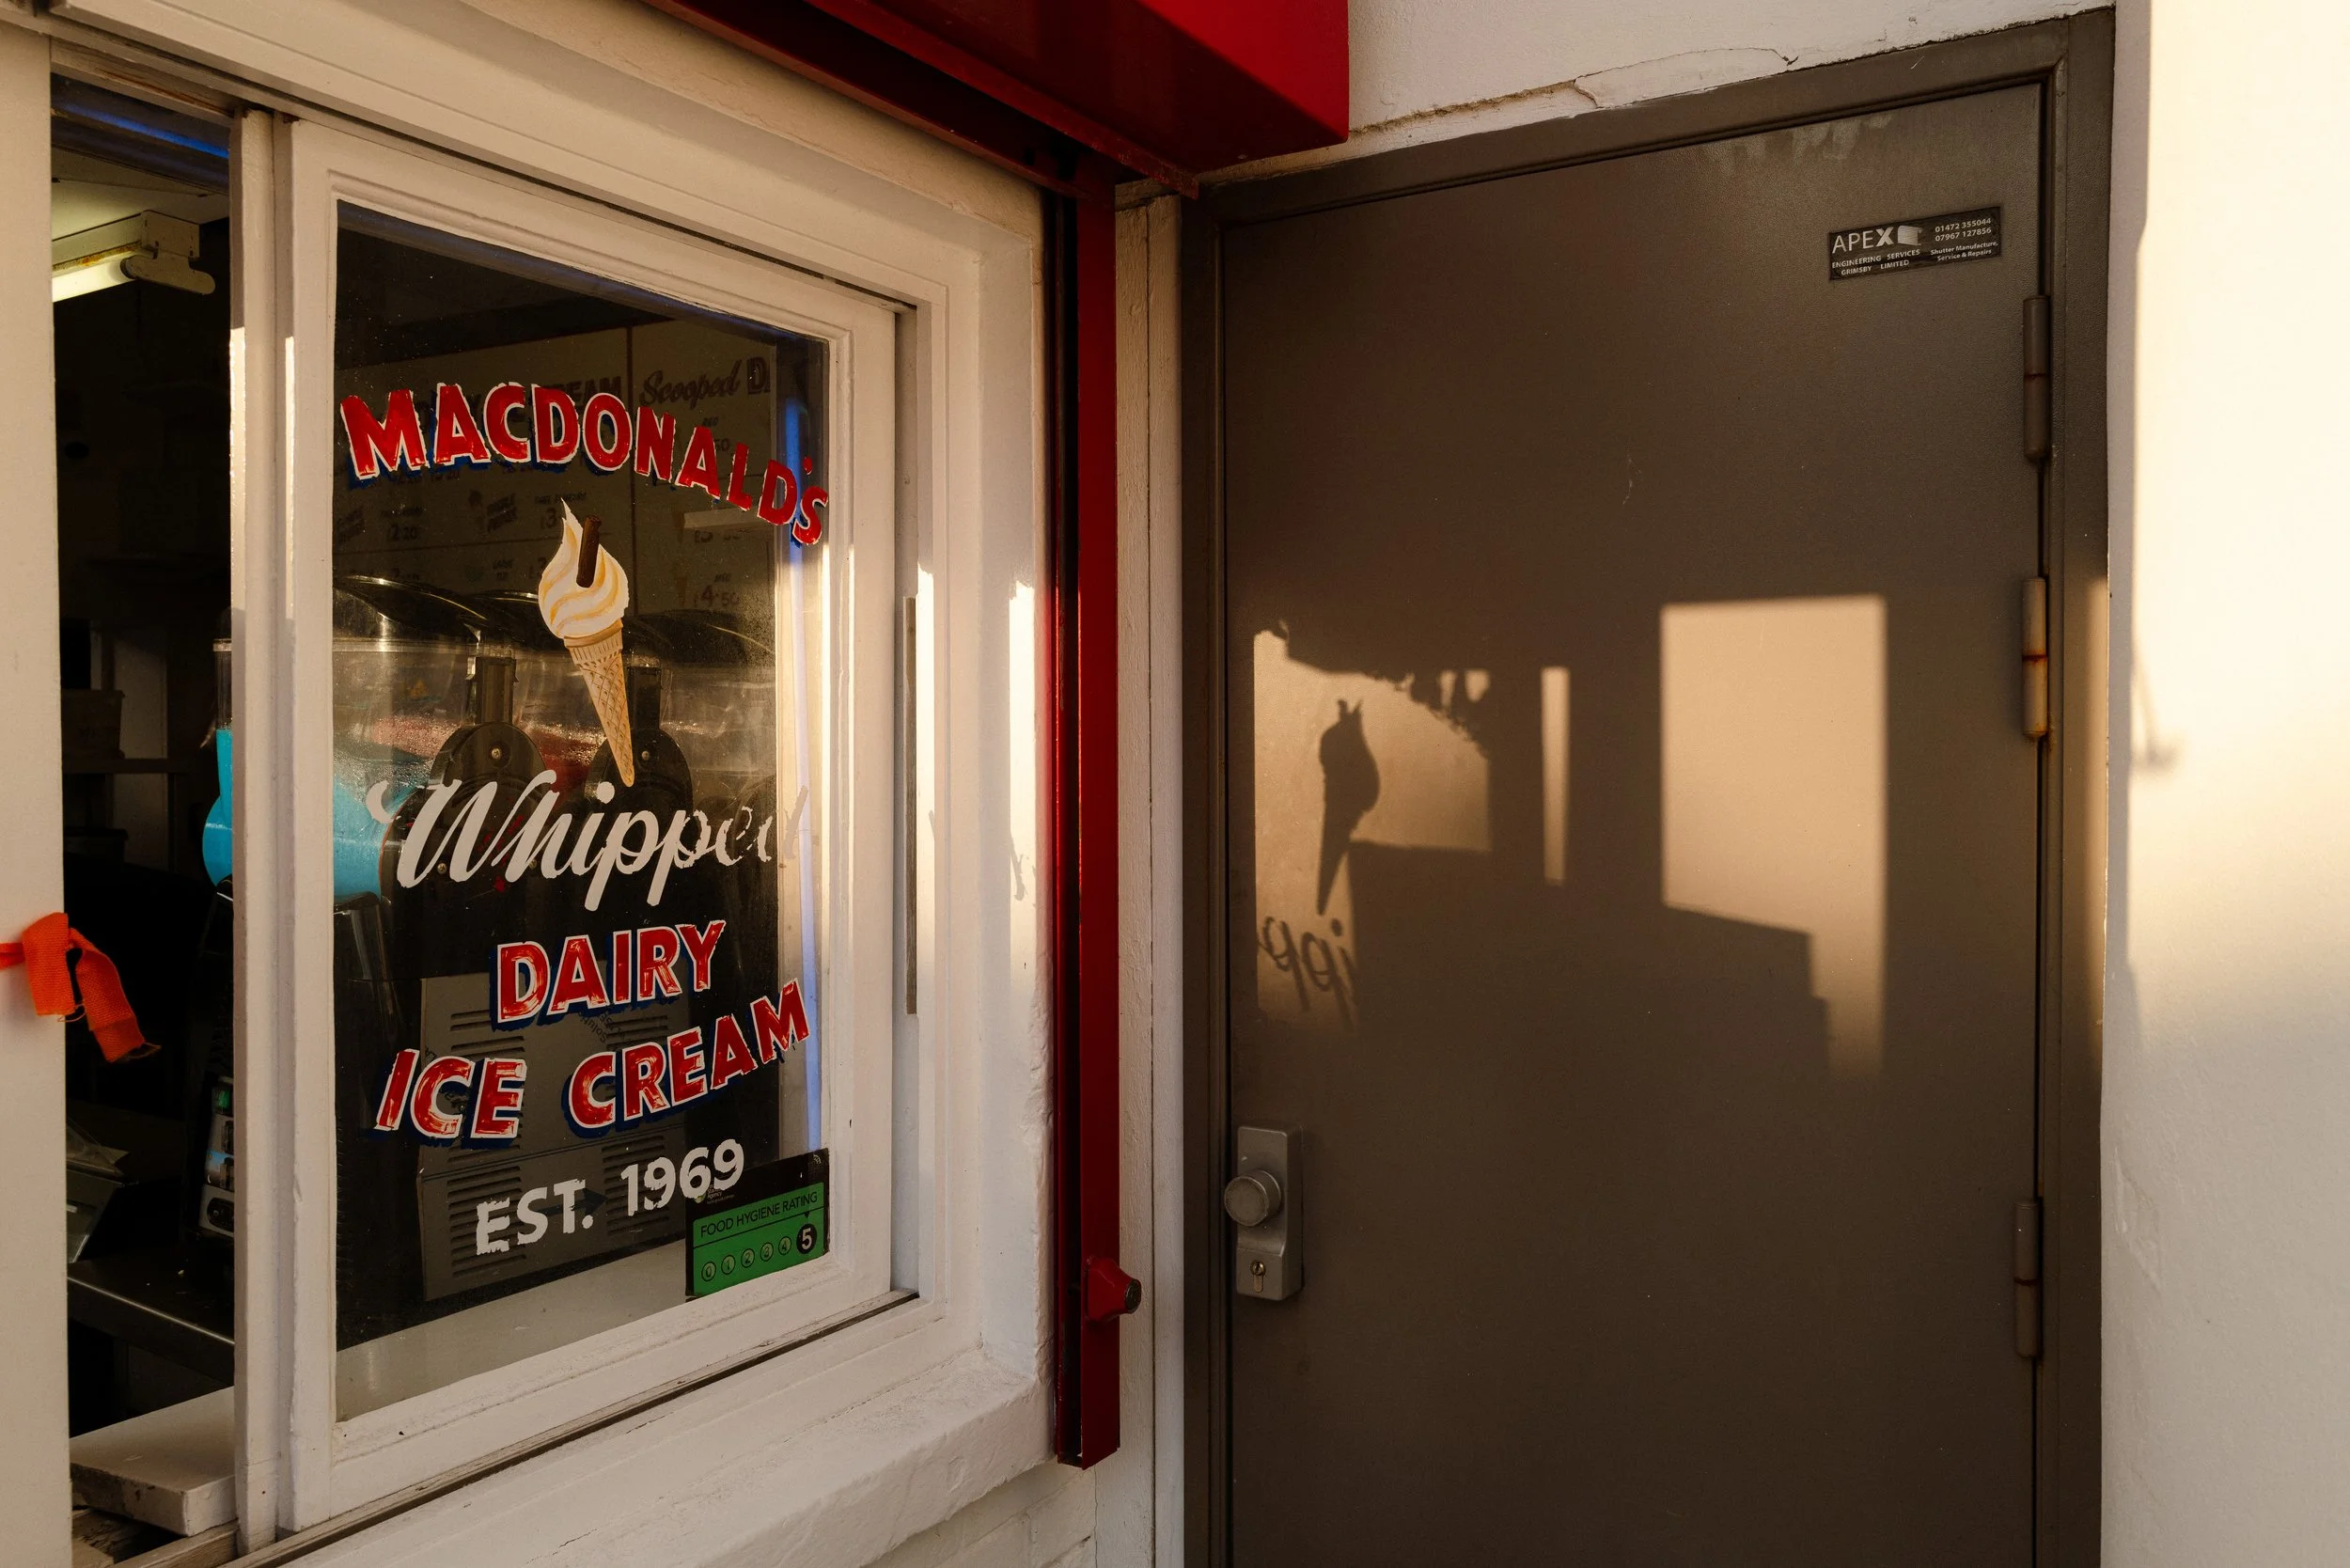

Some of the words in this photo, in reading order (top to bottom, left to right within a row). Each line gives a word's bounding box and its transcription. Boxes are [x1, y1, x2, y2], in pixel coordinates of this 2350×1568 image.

[1935, 223, 1960, 233] 01472
[1961, 217, 1992, 229] 355044
[1935, 231, 1960, 243] 07967
[1962, 227, 1992, 238] 127856
[1831, 226, 1895, 255] APEX
[1930, 245, 1955, 257] Shutter
[1955, 240, 1998, 252] Manufacture,
[1831, 254, 1882, 269] ENGINEERING
[1887, 248, 1920, 260] SERVICES
[1841, 264, 1872, 276] GRIMSBY
[1879, 259, 1910, 270] LIMITED
[1936, 251, 1961, 262] Service
[1967, 248, 1992, 258] Repairs
[639, 358, 742, 411] Scooped
[339, 382, 829, 547] MACDONALD'S
[494, 919, 727, 1027] DAIRY
[372, 1046, 527, 1141] ICE
[567, 978, 811, 1132] CREAM
[475, 1179, 595, 1256] EST.
[620, 1138, 745, 1217] 1969
[699, 1216, 734, 1238] FOOD
[736, 1205, 781, 1228] HYGIENE
[782, 1191, 819, 1212] RATING
[801, 1227, 813, 1251] 5
